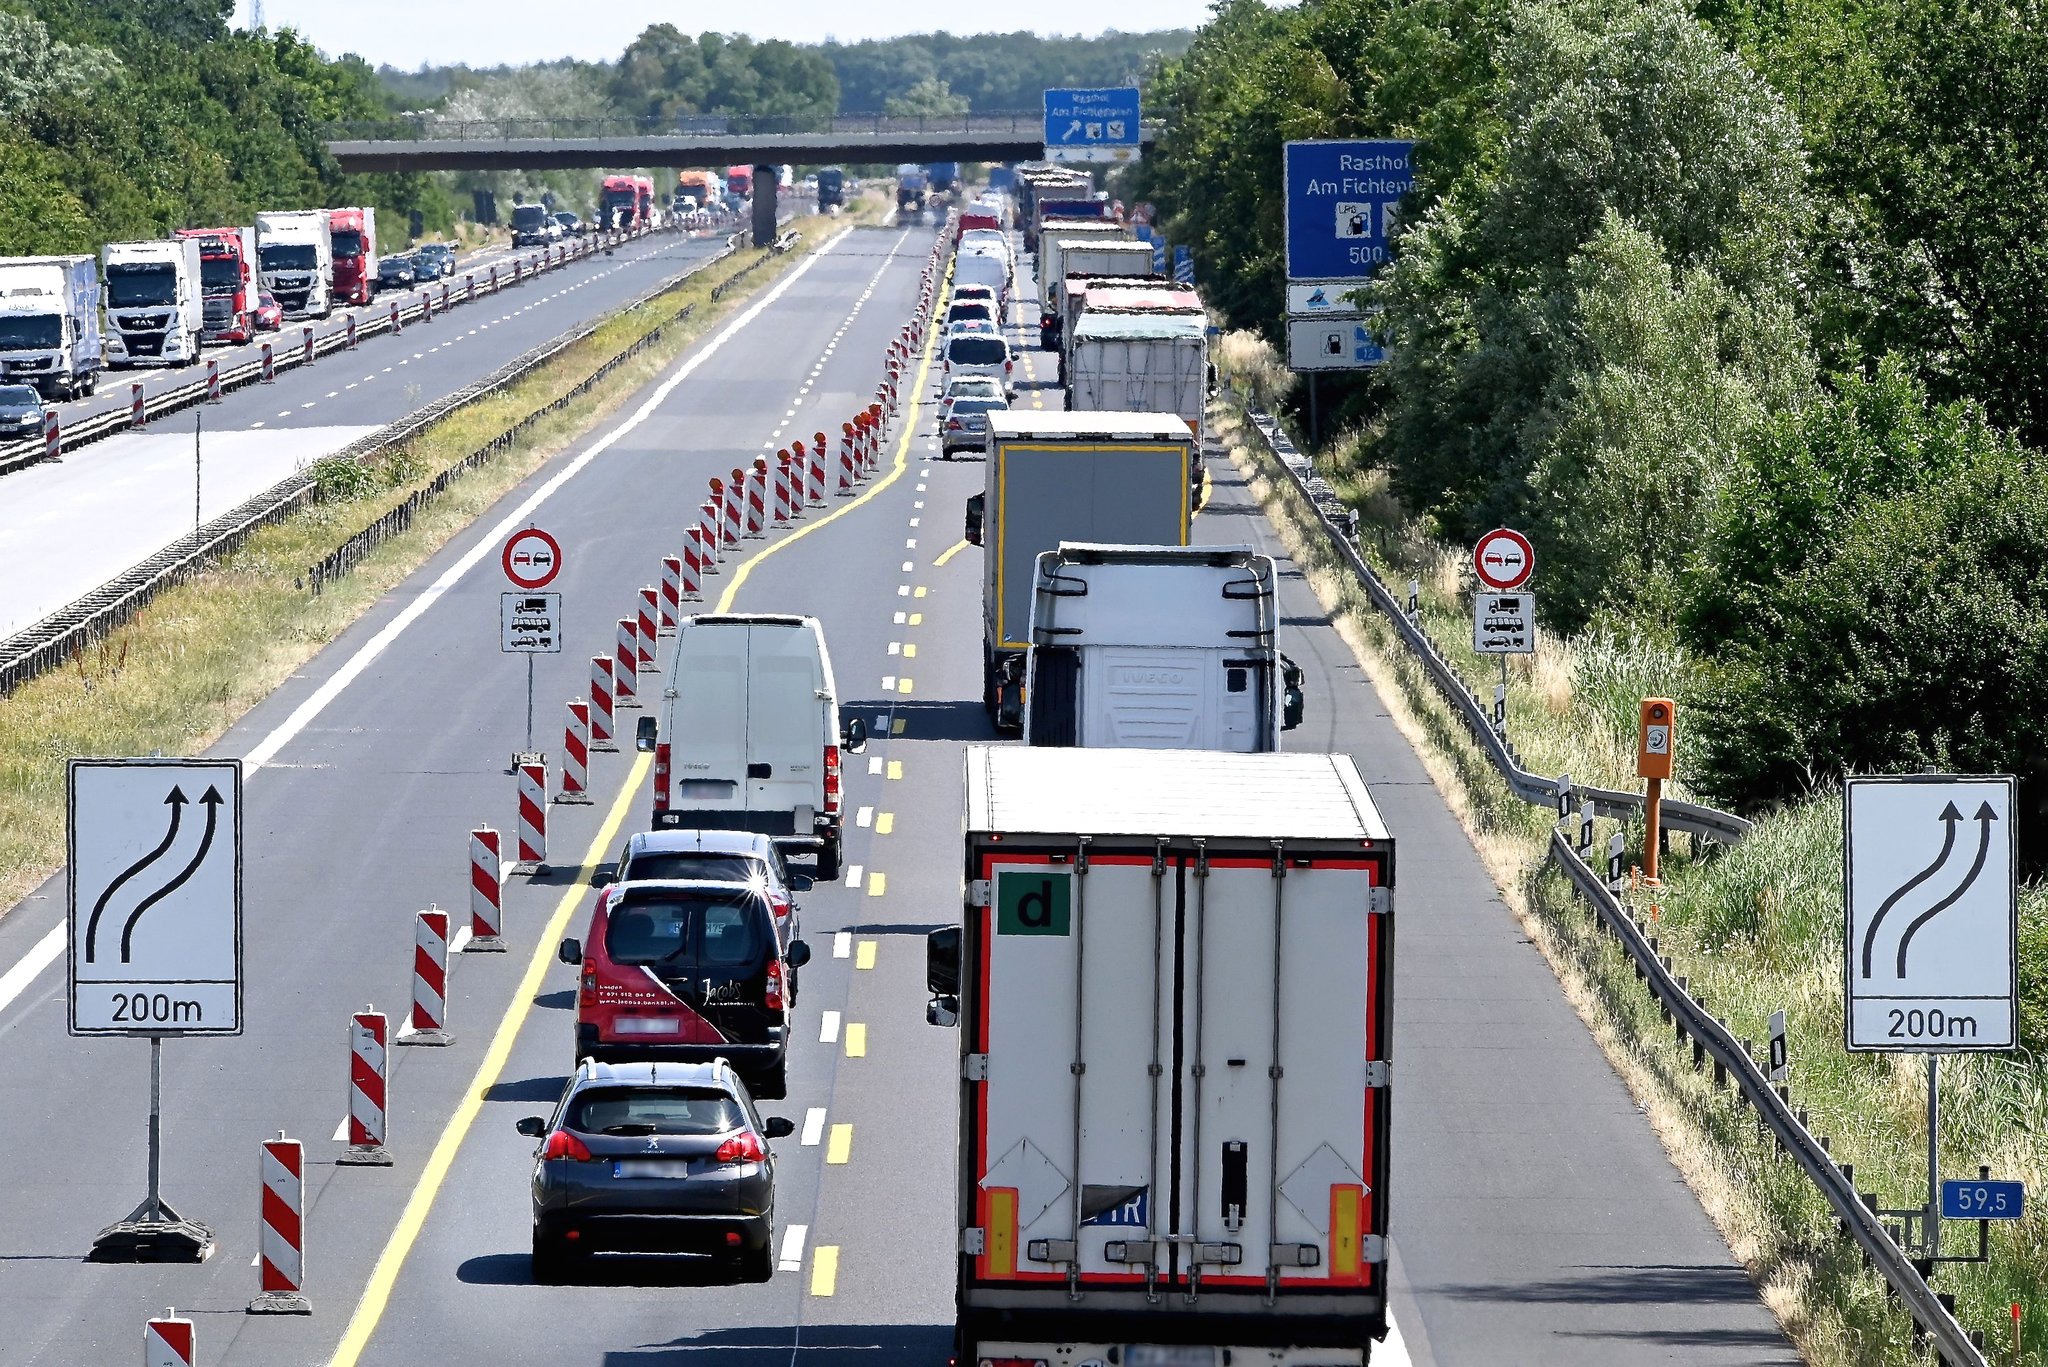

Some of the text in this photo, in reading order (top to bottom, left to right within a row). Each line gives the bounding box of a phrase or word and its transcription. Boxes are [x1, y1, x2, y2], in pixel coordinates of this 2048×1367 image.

[1306, 179, 1338, 195] Am
[1349, 246, 1382, 264] 500
[1123, 672, 1184, 684] IVECO
[1018, 880, 1052, 928] d
[701, 978, 741, 1007] Jacobs
[111, 993, 202, 1022] 200m
[1888, 1008, 1977, 1038] 200m
[1958, 1187, 2007, 1213] 59,5
